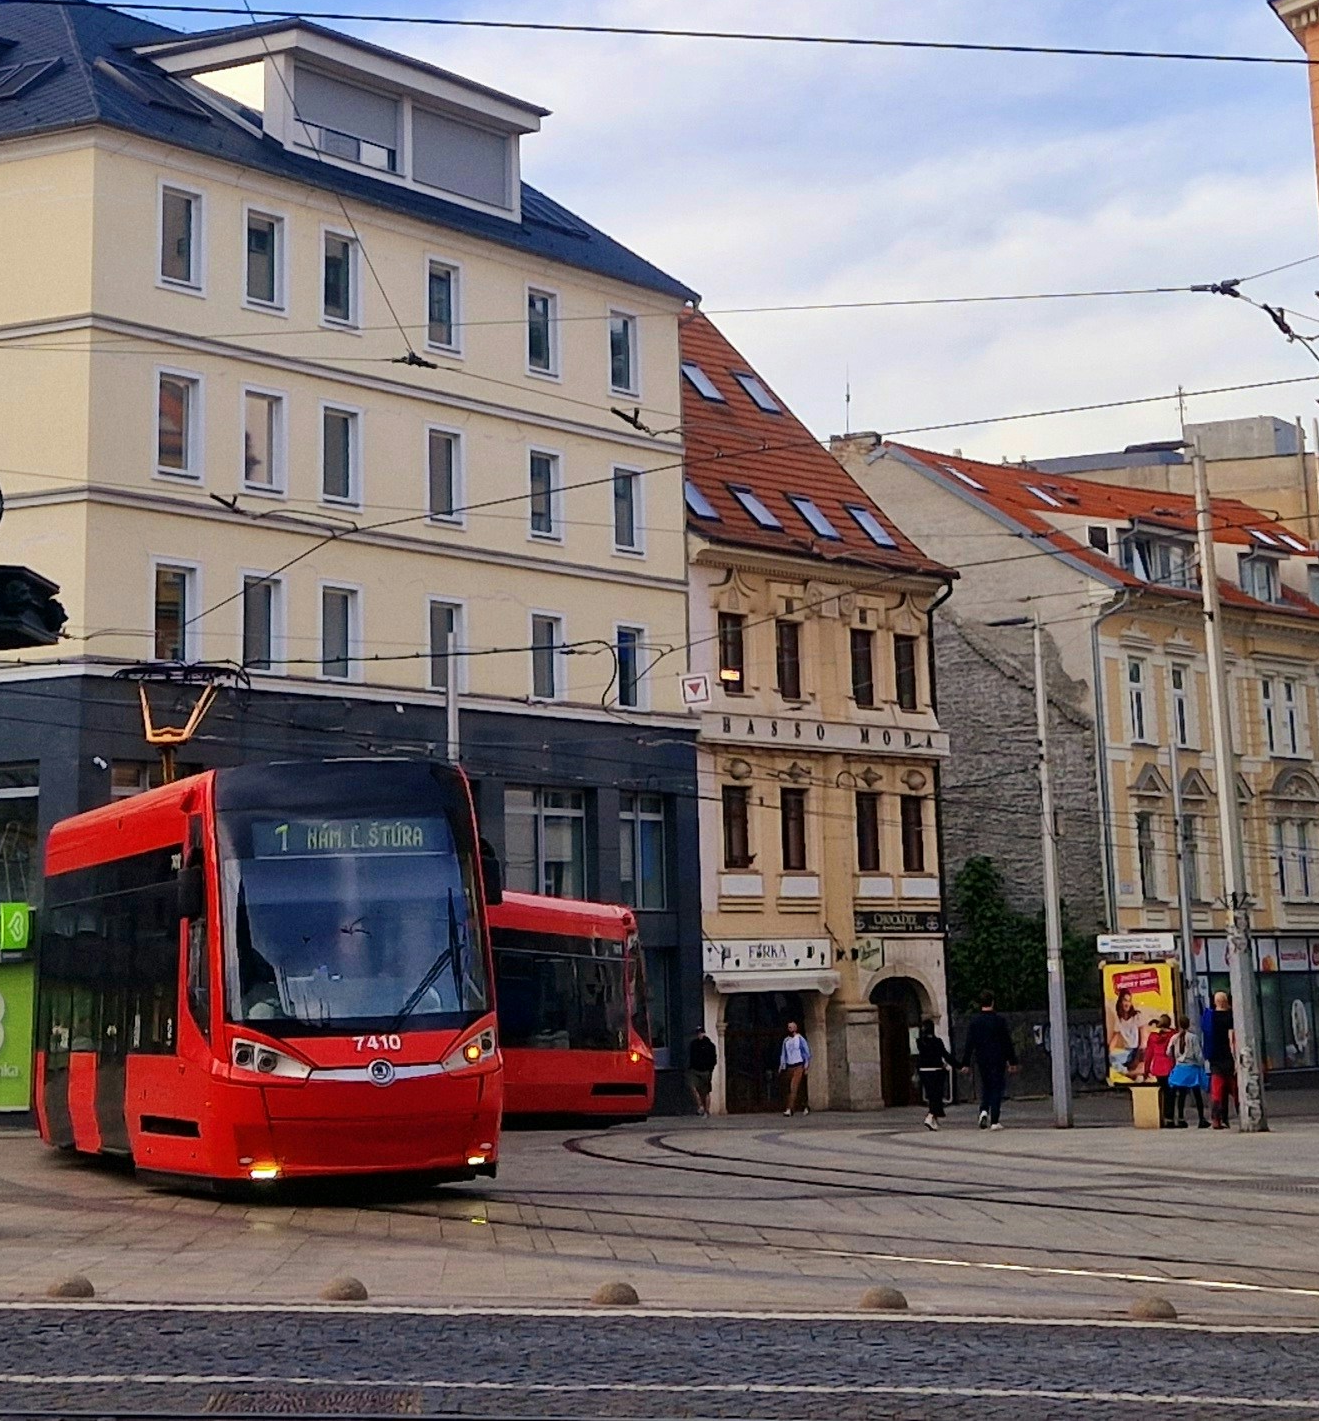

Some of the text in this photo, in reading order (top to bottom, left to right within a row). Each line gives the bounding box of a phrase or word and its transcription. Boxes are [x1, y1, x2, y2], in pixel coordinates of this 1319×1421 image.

[722, 716, 932, 749] HASSO MODA
[352, 1034, 401, 1051] 7410
